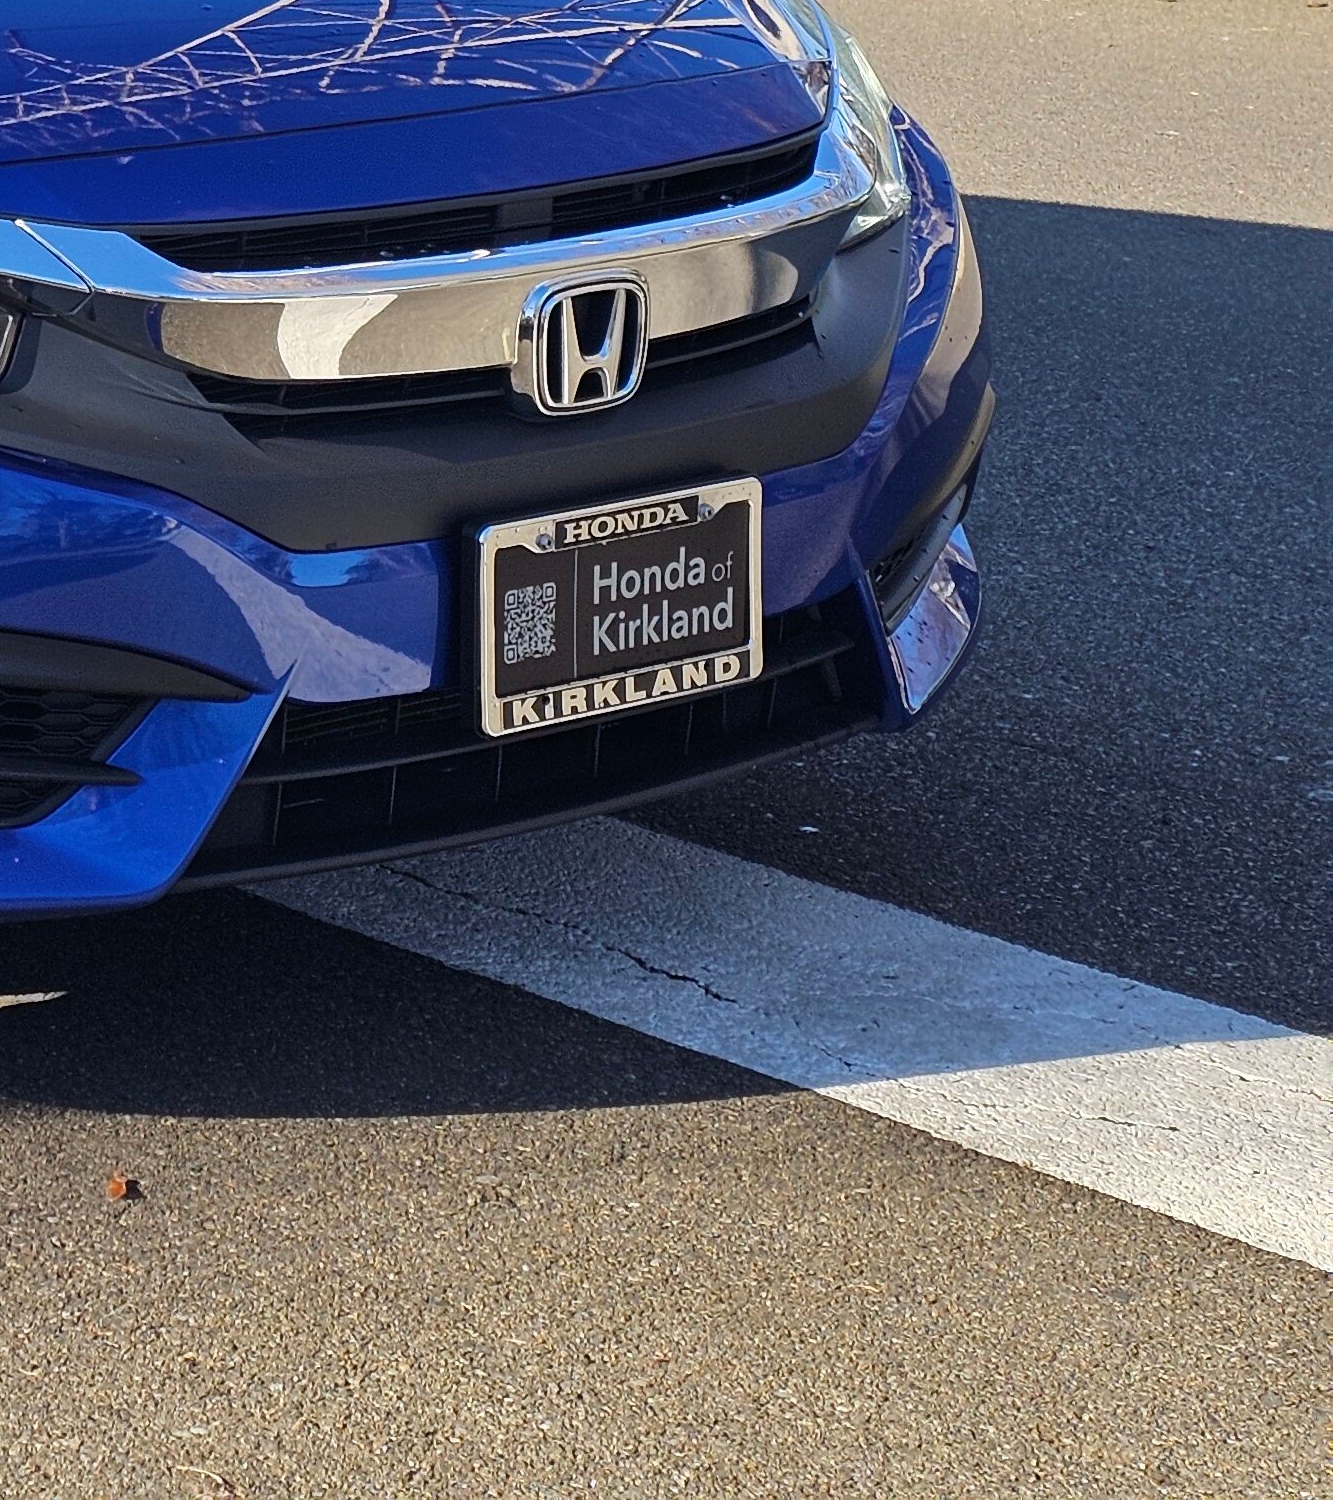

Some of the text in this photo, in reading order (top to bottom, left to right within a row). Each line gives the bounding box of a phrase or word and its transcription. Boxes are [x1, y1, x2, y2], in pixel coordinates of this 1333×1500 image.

[562, 502, 690, 545] HONDA
[592, 546, 735, 605] Honda of
[592, 587, 734, 656] Kirkland
[512, 655, 741, 727] KIRKLAND
